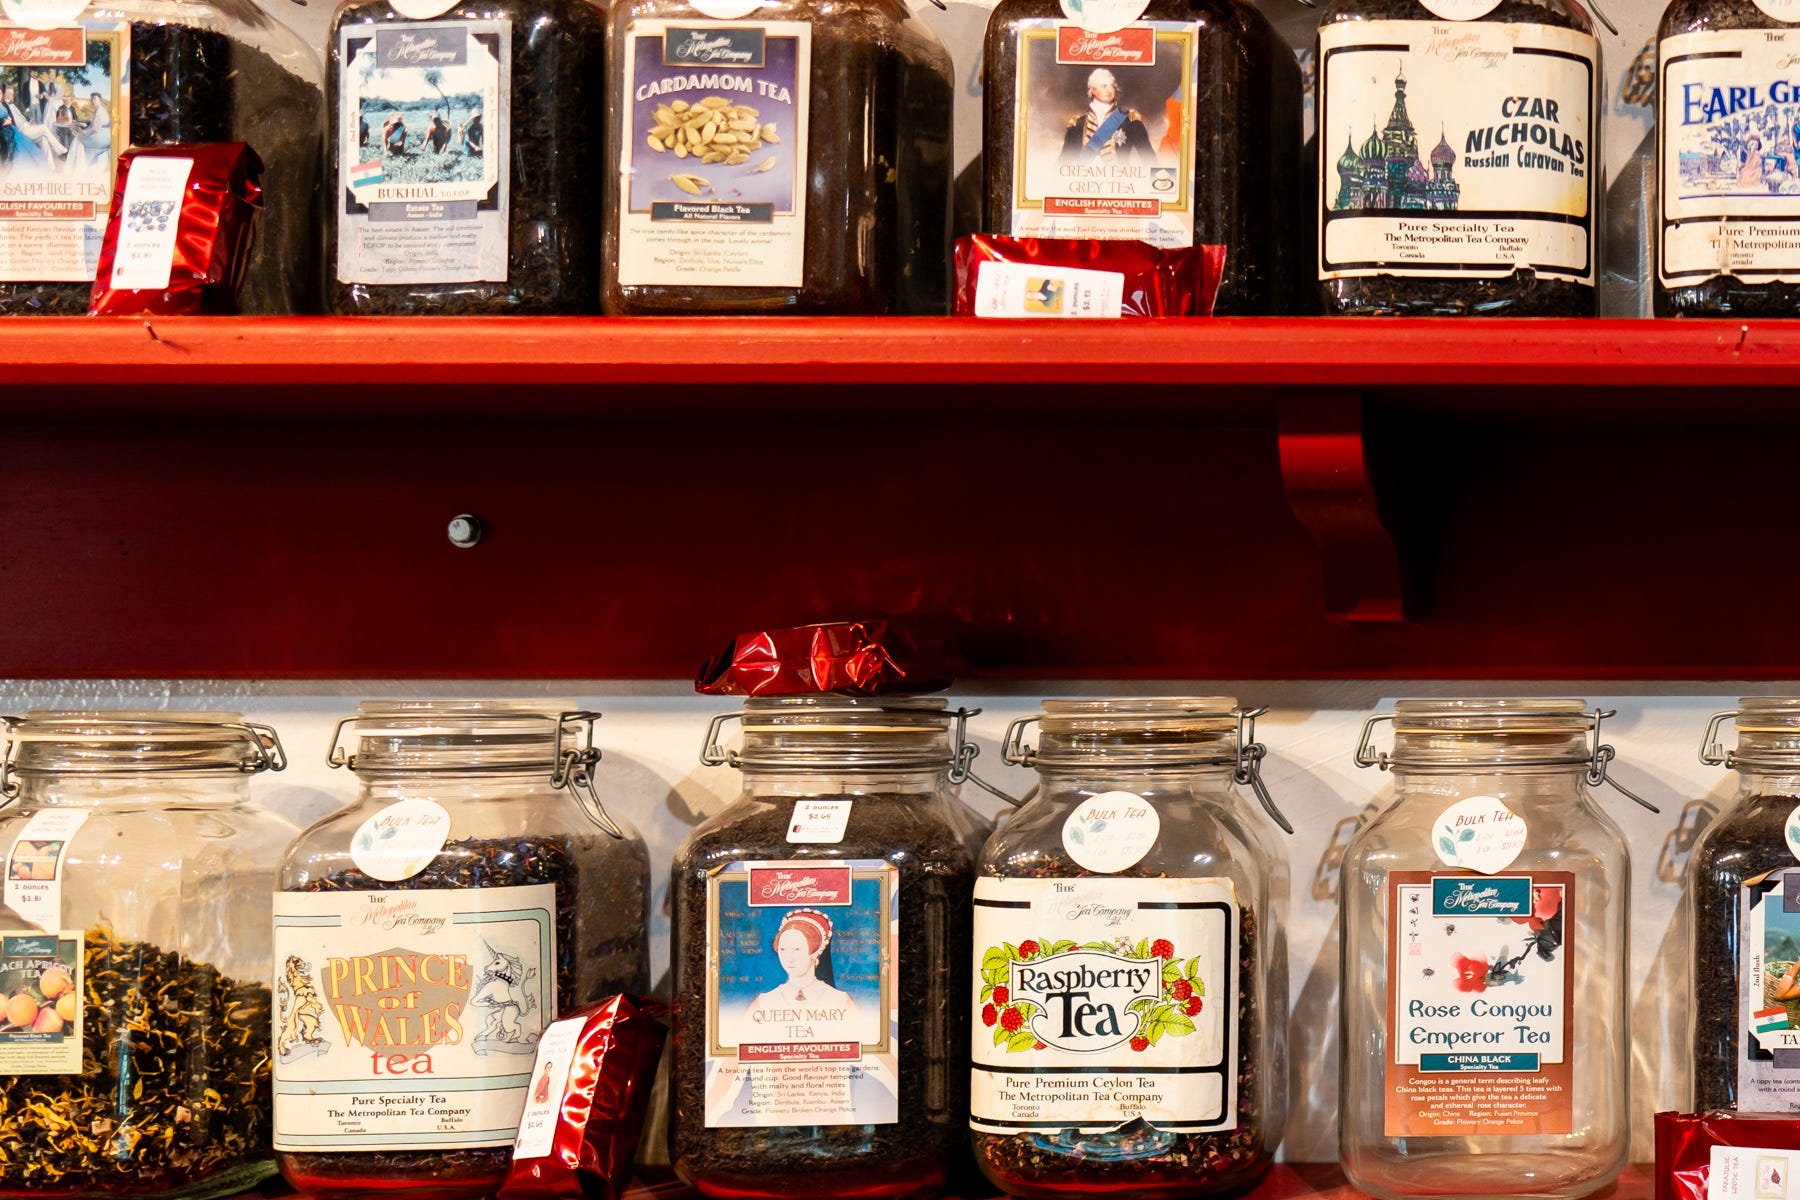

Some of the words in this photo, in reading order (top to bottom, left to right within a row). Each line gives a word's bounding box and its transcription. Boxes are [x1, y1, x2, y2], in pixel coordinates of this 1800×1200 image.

[636, 75, 752, 101] CARDAMOM
[758, 80, 791, 104] TEA
[1502, 97, 1559, 123] CZAR
[1681, 83, 1765, 126] EARL
[1465, 123, 1584, 164] NICHOLAS
[1465, 151, 1509, 167] Russian
[1517, 145, 1564, 172] Caravan
[1571, 164, 1584, 177] Tea
[1059, 166, 1107, 178] CREAM
[1112, 166, 1146, 178] EARL
[4, 183, 72, 196] SAPPHIRE
[77, 183, 107, 196] TEA
[377, 188, 438, 199] BUKHIAL
[1069, 182, 1101, 193] GREY
[1109, 182, 1135, 193] TEA
[674, 205, 709, 213] Flavored
[712, 205, 733, 213] Black
[1055, 199, 1095, 208] ENGLISH
[1097, 200, 1152, 208] FAVOURITES
[1399, 223, 1427, 232] Pure
[1433, 223, 1488, 233] Specialty
[1493, 224, 1514, 232] Tea
[1749, 226, 1800, 236] Premium
[1467, 235, 1482, 243] Tea
[1086, 809, 1116, 821] BULK
[1124, 808, 1146, 819] TEA
[327, 953, 470, 1000] PRINCE
[1018, 965, 1150, 993] Raspberry
[378, 991, 422, 1010] of
[752, 1010, 802, 1024] QUEEN
[806, 1008, 846, 1022] MARY
[1045, 991, 1122, 1039] Tea
[1409, 999, 1461, 1018] Rose
[1471, 999, 1552, 1022] Congou
[334, 1001, 463, 1047] WALES
[784, 1025, 814, 1038] TEA
[1409, 1026, 1504, 1049] Emperor
[1514, 1025, 1550, 1044] Tea
[748, 1045, 790, 1053] ENGLISH
[792, 1044, 850, 1052] FAVOURITES
[371, 1052, 433, 1075] tea
[1006, 1078, 1031, 1088] Pure
[1035, 1078, 1089, 1088] Premium
[1092, 1078, 1133, 1090] Ceylon
[1136, 1078, 1155, 1088] Tea
[1409, 1078, 1436, 1086] Congou
[1451, 1078, 1476, 1086] general
[1497, 1077, 1530, 1085] describing
[352, 1096, 375, 1105] Pure
[379, 1095, 425, 1105] Specialty
[429, 1094, 446, 1104] Tea
[999, 1091, 1018, 1101] The
[1020, 1091, 1089, 1102] Metropolitan
[1092, 1091, 1110, 1101] Tea
[1113, 1091, 1163, 1103] Company
[328, 1109, 345, 1118] The
[348, 1108, 406, 1119] Metropolitan
[410, 1107, 425, 1117] Tea
[428, 1106, 471, 1117] Company
